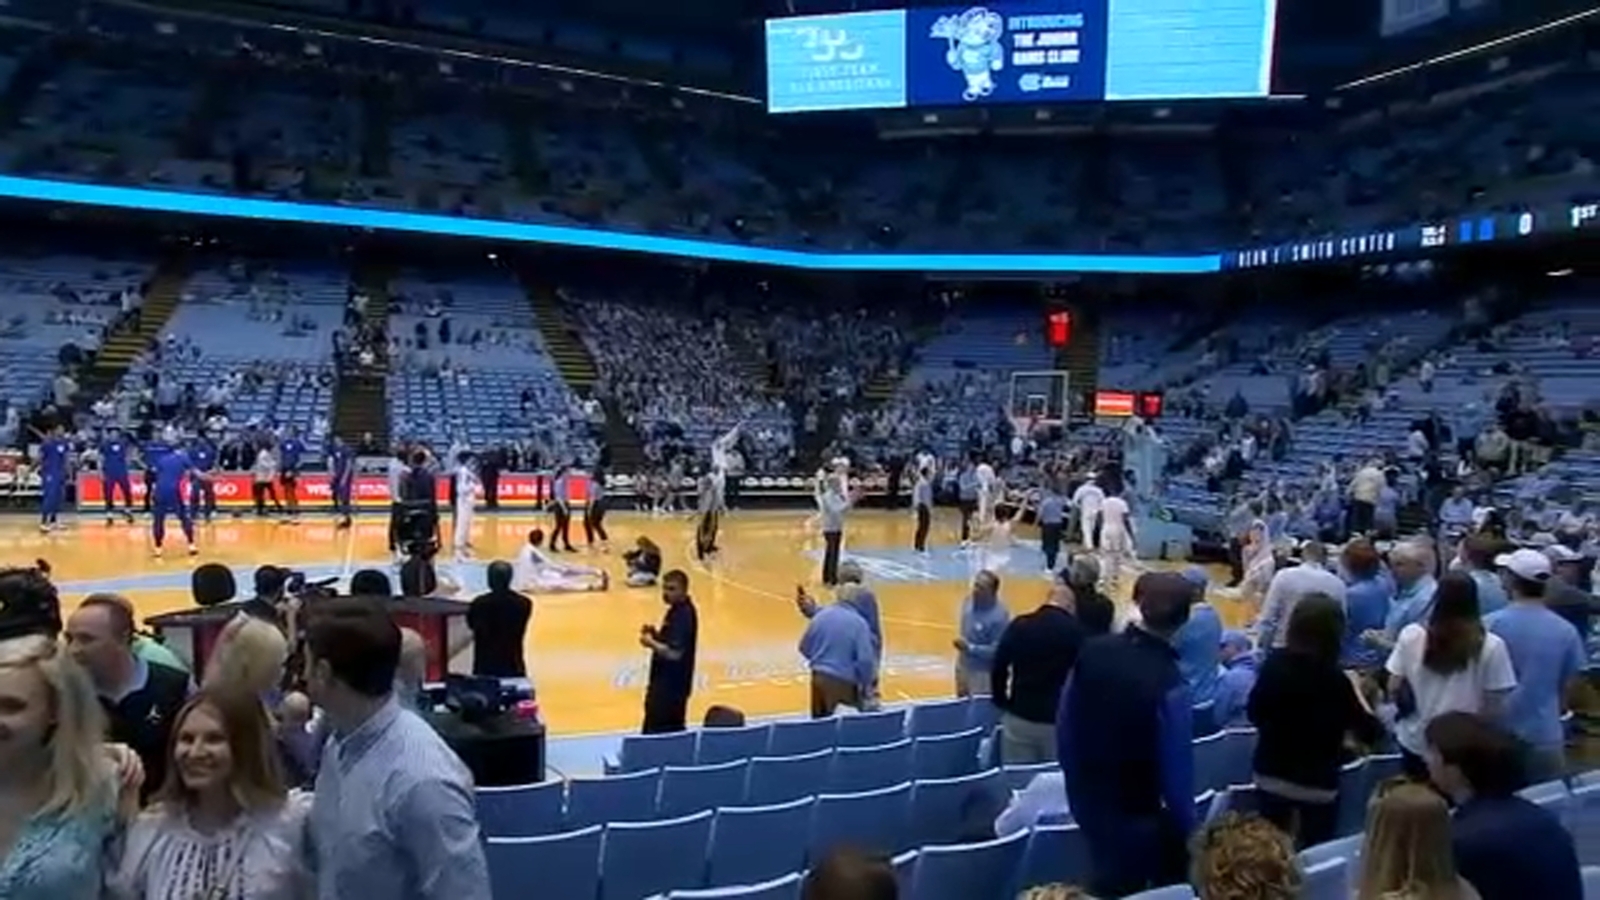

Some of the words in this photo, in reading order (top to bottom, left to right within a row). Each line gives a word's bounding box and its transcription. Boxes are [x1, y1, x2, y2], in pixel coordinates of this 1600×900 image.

[1008, 12, 1083, 31] INTRODUCING
[1013, 33, 1034, 48] THE
[1519, 212, 1533, 235] 0
[1239, 250, 1267, 268] DEAN
[1292, 240, 1333, 262] SMITH
[1341, 232, 1395, 257] CENTER
